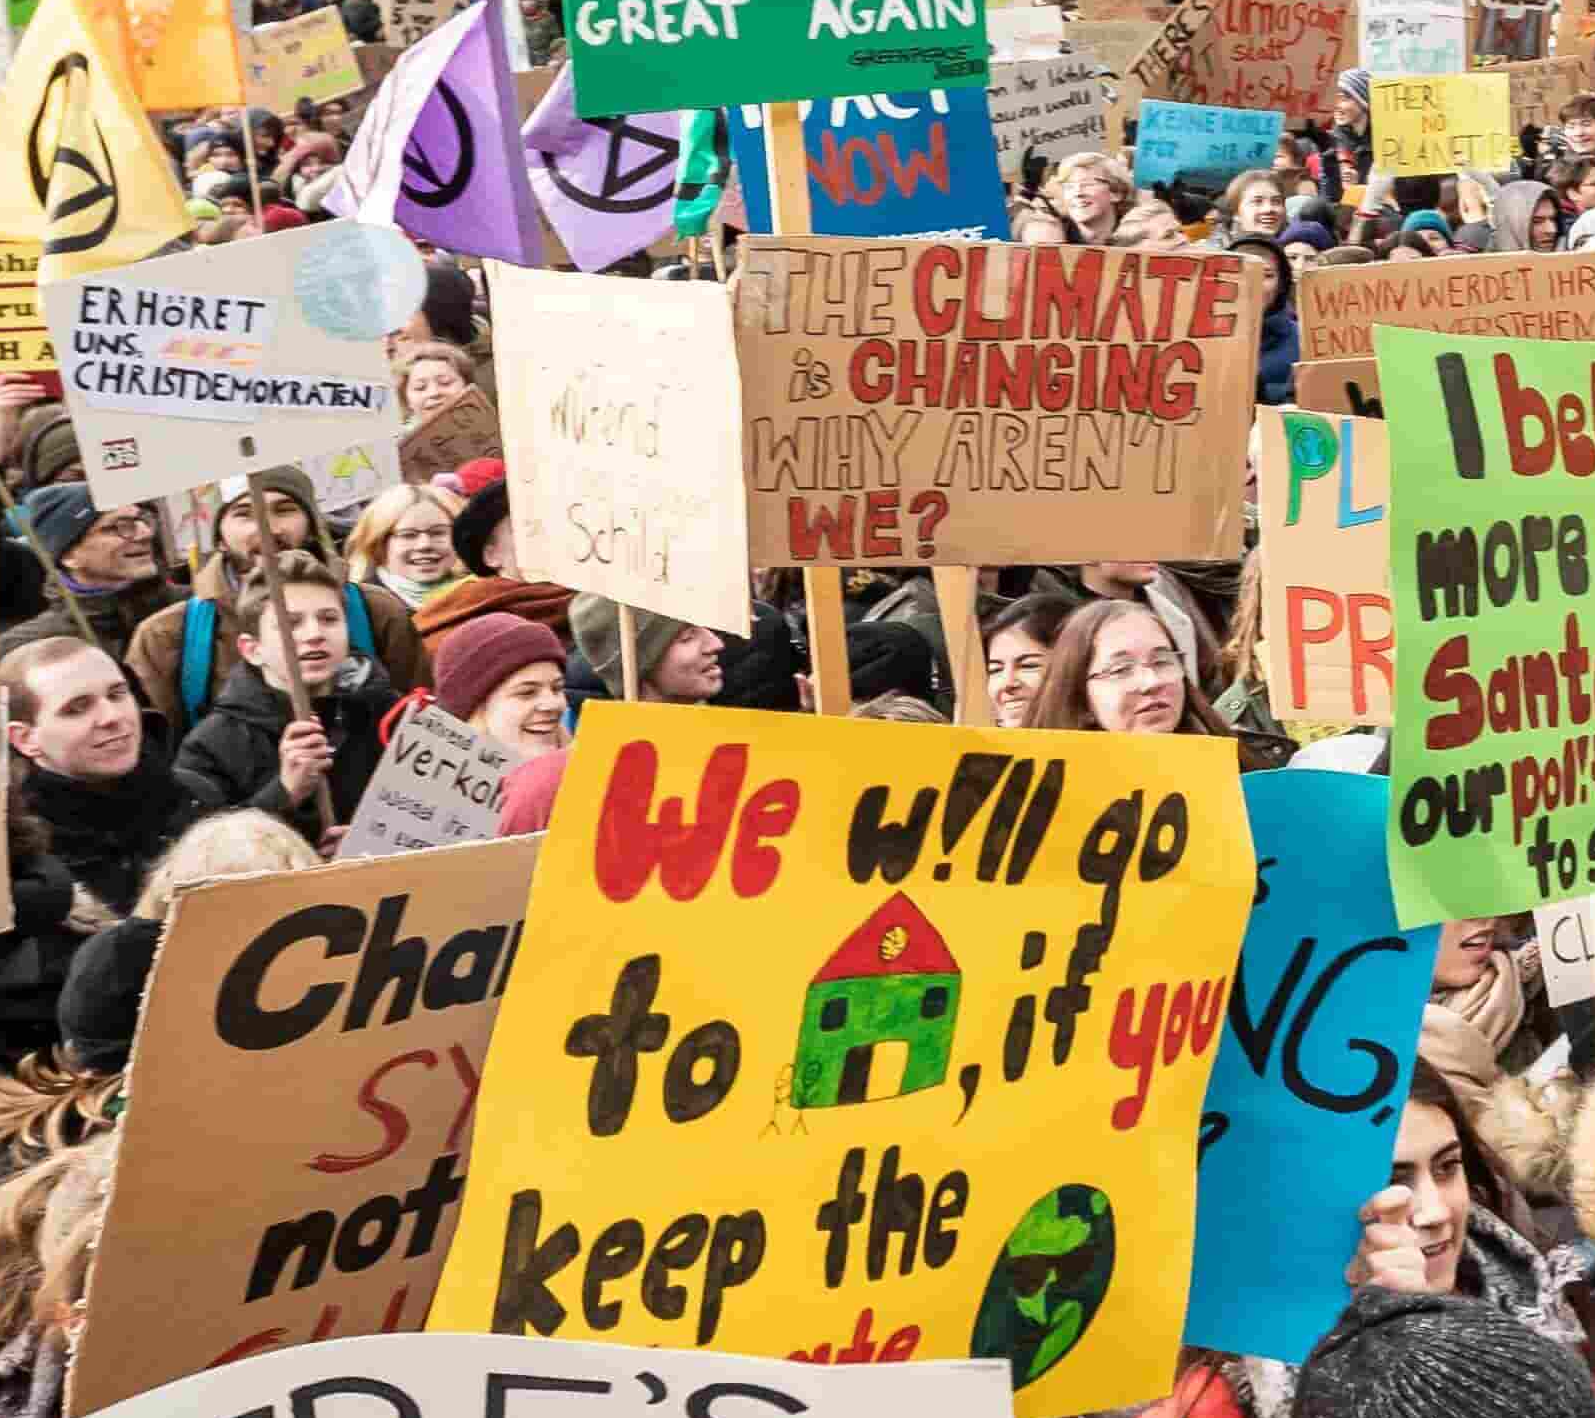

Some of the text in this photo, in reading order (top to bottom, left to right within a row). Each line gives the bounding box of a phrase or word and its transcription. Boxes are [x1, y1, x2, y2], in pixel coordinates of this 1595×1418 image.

[807, 121, 951, 206] NOW
[742, 244, 1242, 342] THE CLIMATE
[1311, 276, 1410, 321] WANN
[1416, 266, 1537, 311] WERDET
[789, 338, 1203, 421] is CHANGING
[1435, 351, 1485, 480] I
[752, 409, 922, 492] WHY
[933, 406, 1201, 494] AREN'T
[788, 488, 951, 560] WE?
[1415, 511, 1590, 622] more
[594, 738, 801, 905] We
[1077, 788, 1190, 955] go
[1400, 761, 1507, 848] our
[1527, 815, 1577, 898] to
[214, 892, 527, 1051] Cha
[568, 921, 1228, 1139] to if you
[244, 1151, 468, 1305] not
[490, 1188, 768, 1345] keep
[815, 1143, 970, 1289] the
